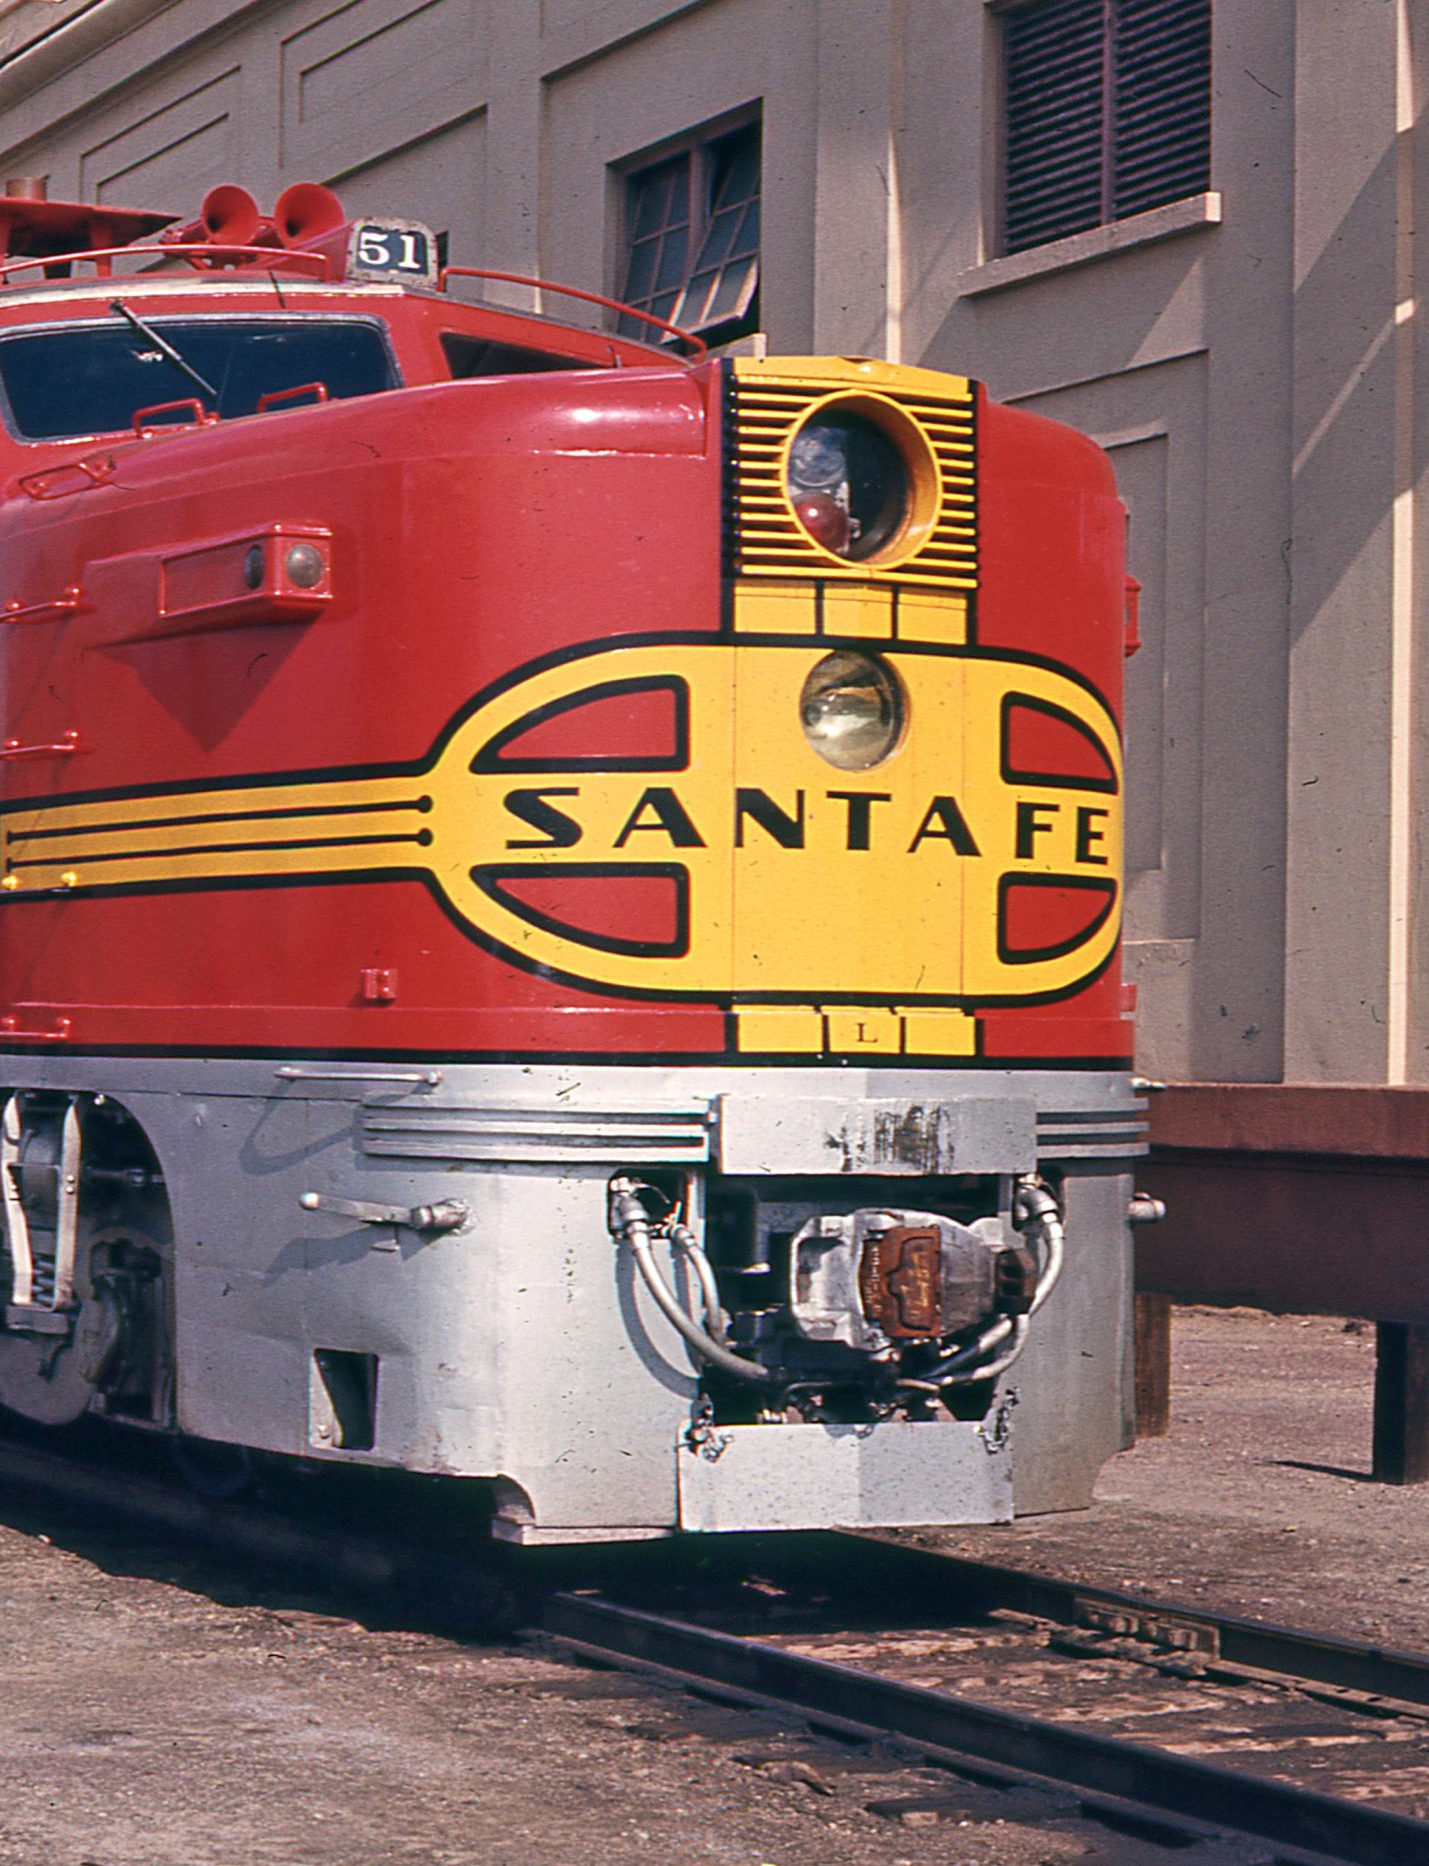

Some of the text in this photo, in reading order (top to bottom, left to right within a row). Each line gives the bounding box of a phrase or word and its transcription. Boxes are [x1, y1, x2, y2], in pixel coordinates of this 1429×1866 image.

[358, 232, 421, 269] 51
[503, 787, 1109, 865] SANTA FE
[856, 1022, 878, 1043] L
